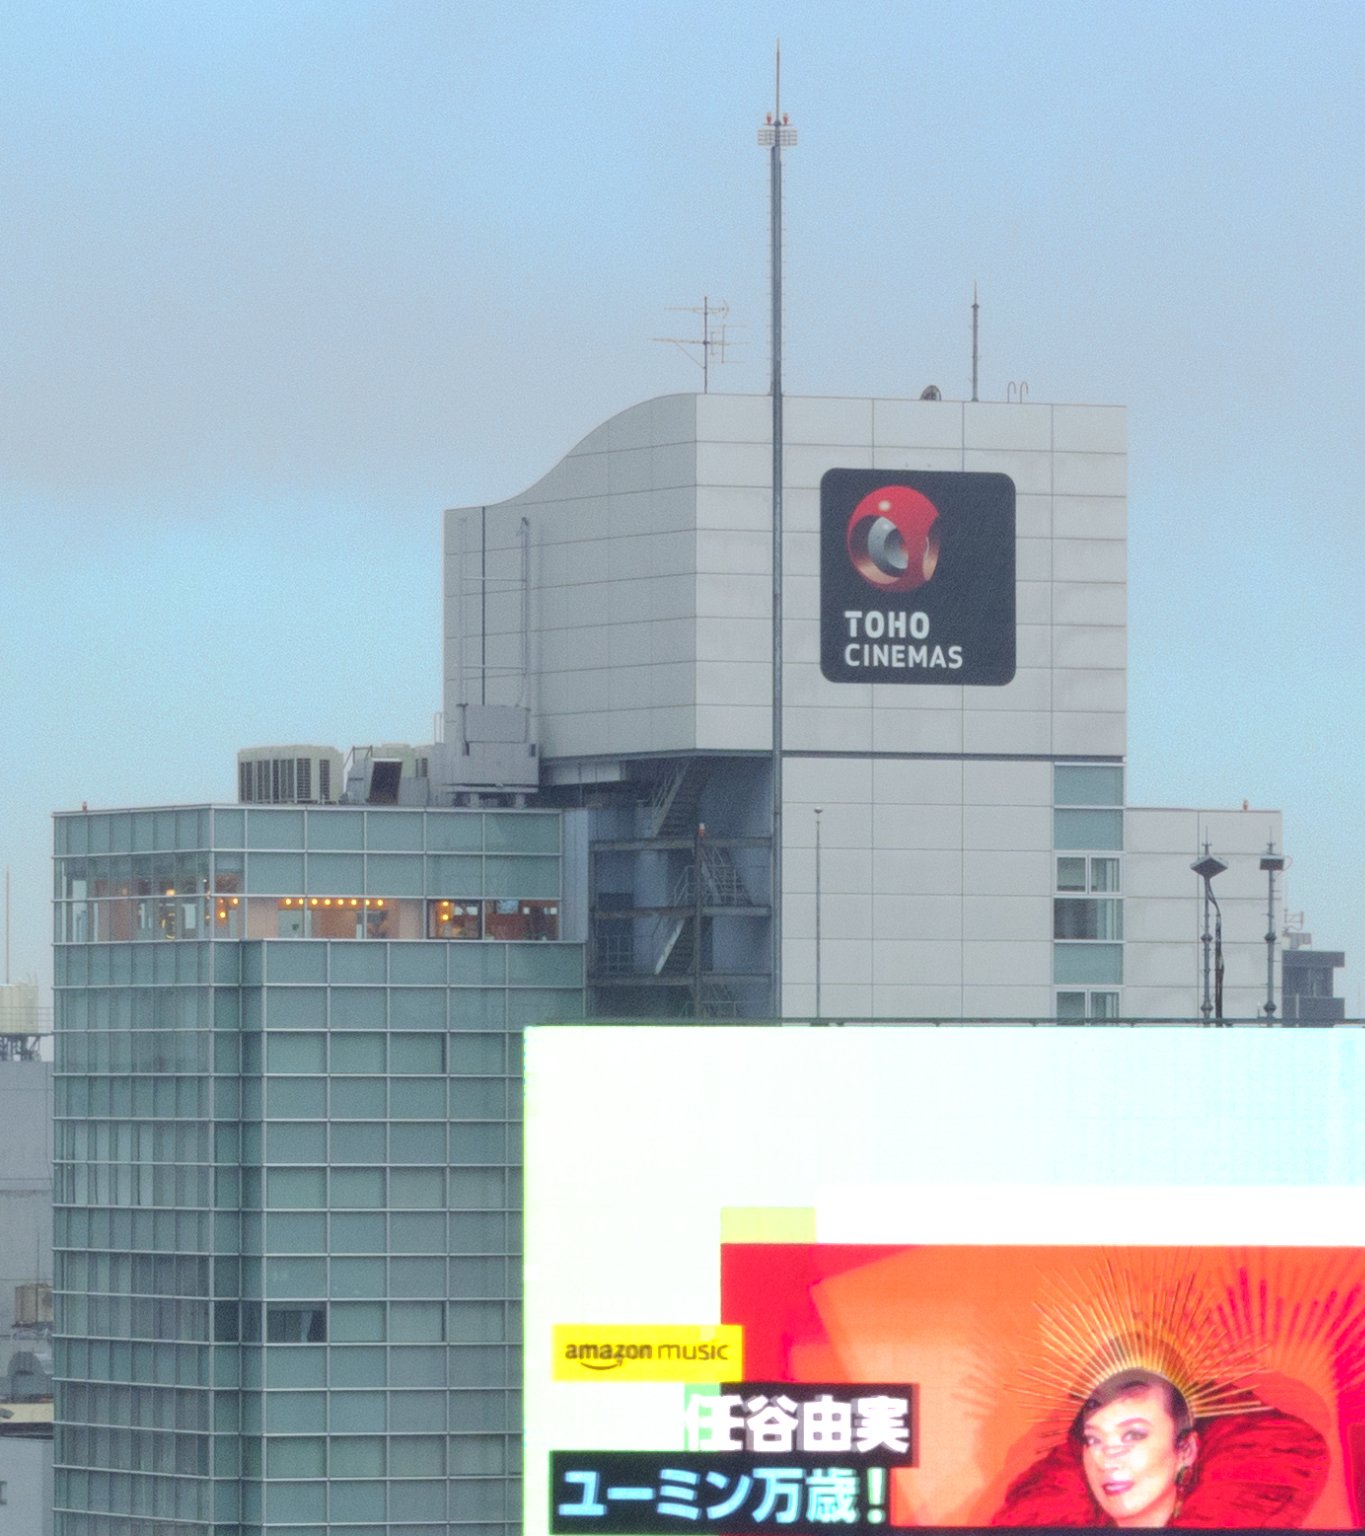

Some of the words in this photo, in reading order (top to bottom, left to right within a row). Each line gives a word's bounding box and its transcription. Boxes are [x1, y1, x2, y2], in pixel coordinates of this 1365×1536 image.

[844, 610, 930, 639] TOHO
[844, 643, 963, 669] CINEMAS
[565, 1341, 653, 1363] amazon
[657, 1340, 729, 1361] music
